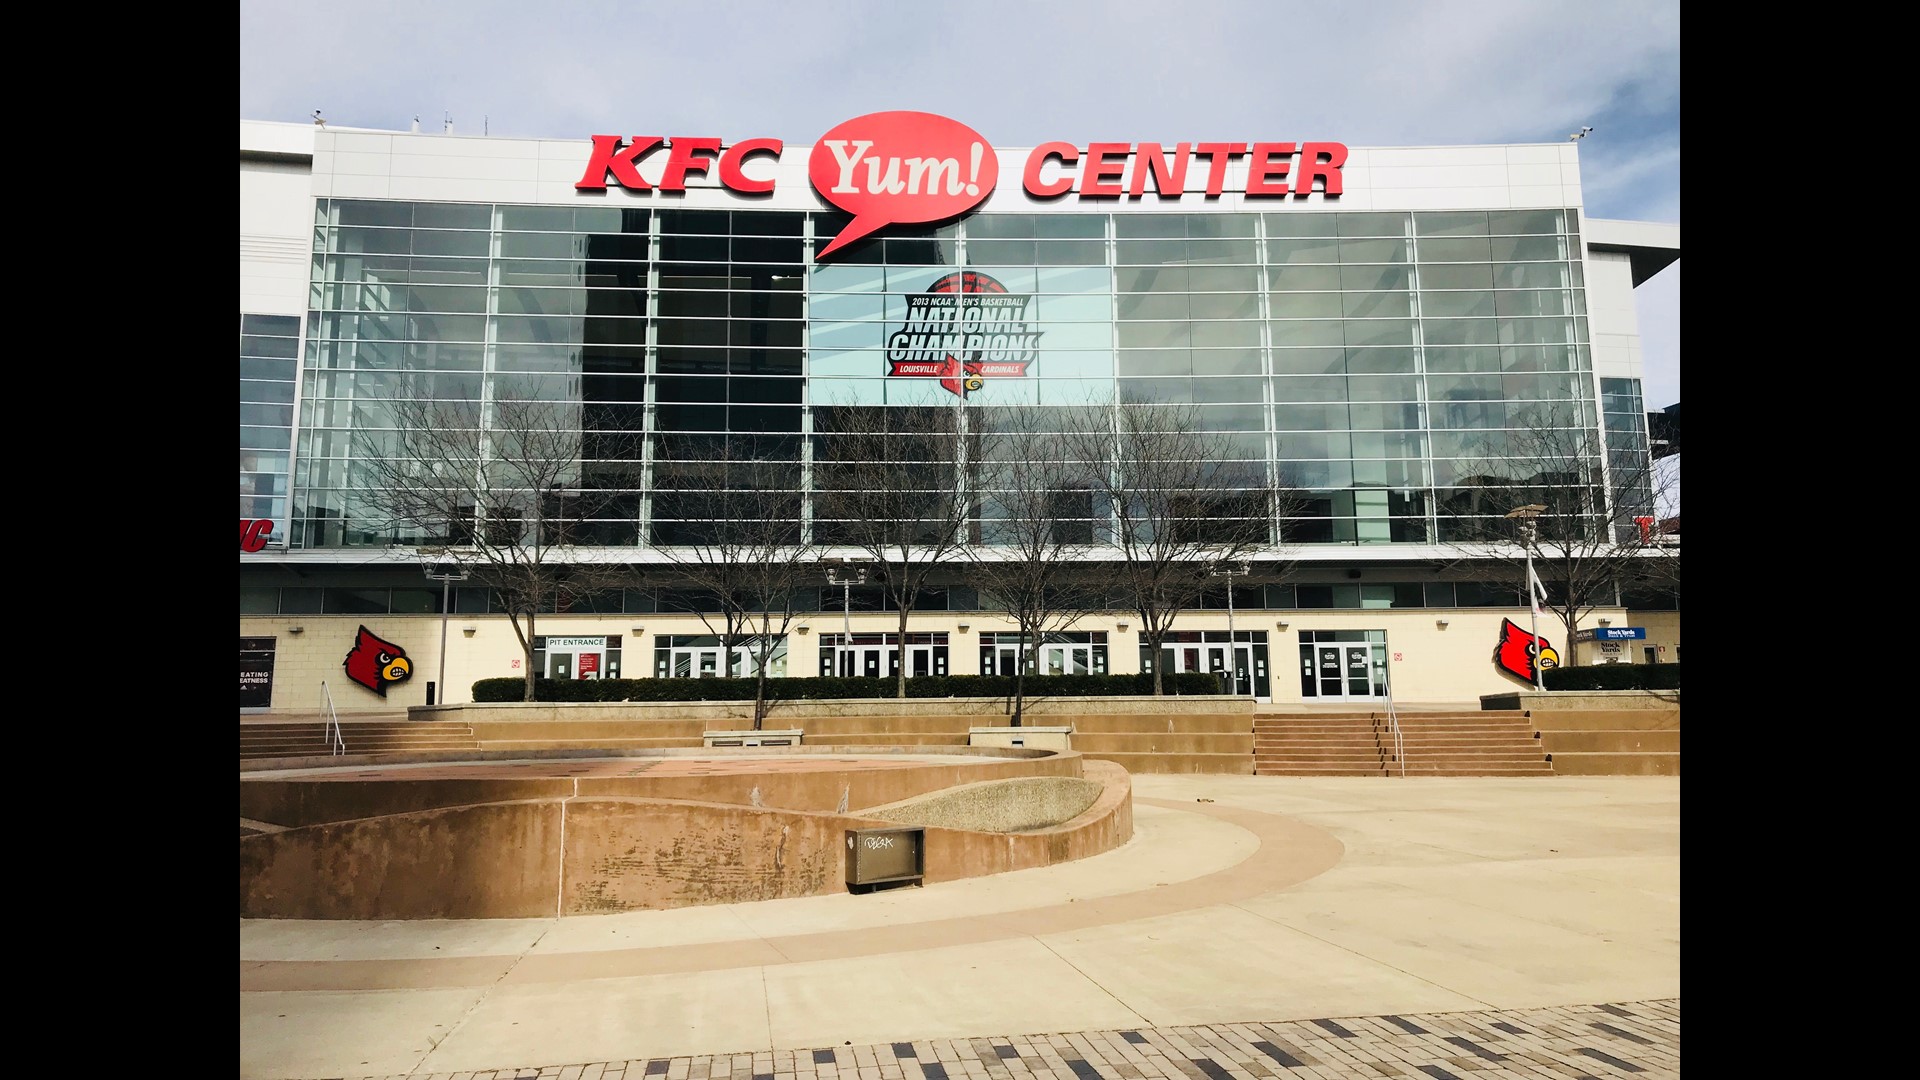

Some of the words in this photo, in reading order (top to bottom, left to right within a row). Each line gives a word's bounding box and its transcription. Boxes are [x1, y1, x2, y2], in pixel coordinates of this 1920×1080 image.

[575, 134, 784, 194] KFC
[823, 139, 984, 197] Yum!
[1022, 141, 1349, 200] CENTER
[912, 297, 929, 306] 2013
[954, 297, 979, 306] MEN'S
[980, 297, 1024, 306] BASKETBALL
[905, 307, 1024, 333] NATIONAL
[889, 334, 1039, 361] CHAMPIONS
[899, 365, 939, 373] LOUISVILLE
[981, 365, 1019, 373] CARDINALS
